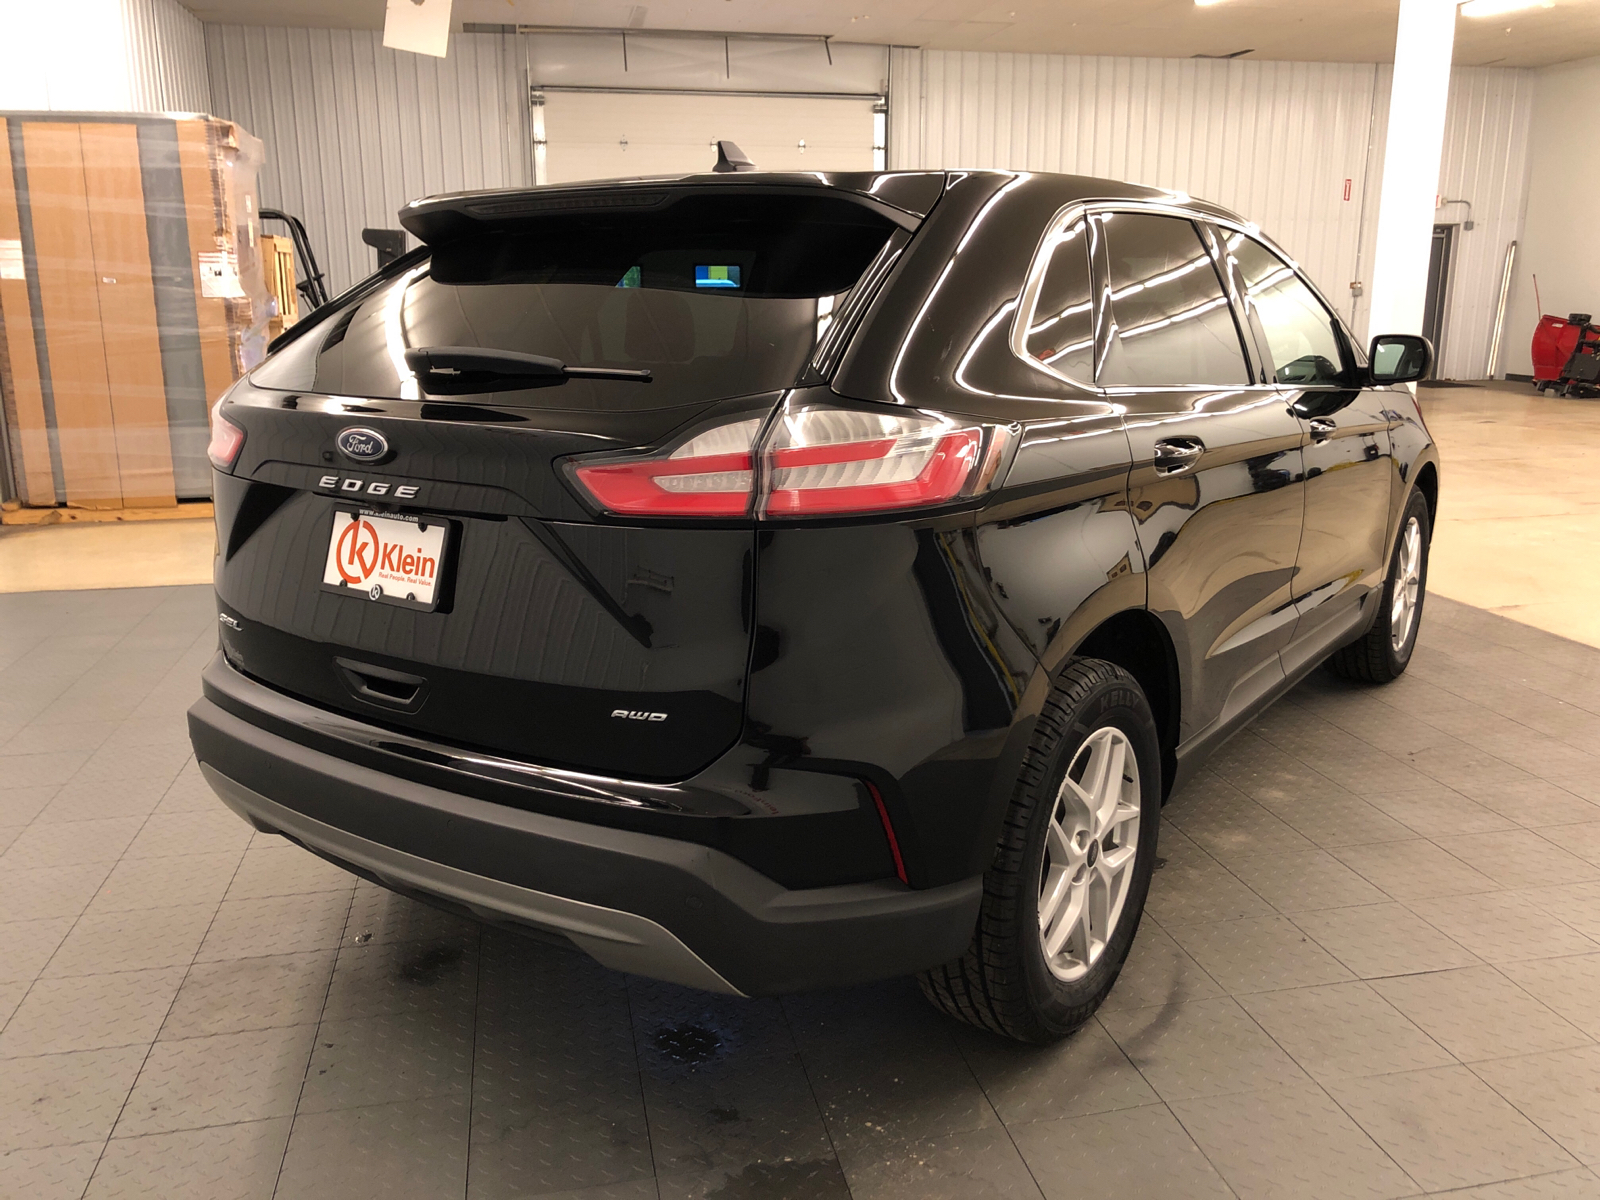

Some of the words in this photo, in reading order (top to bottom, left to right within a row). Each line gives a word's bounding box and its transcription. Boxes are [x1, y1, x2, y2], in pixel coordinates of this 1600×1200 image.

[346, 434, 374, 454] Ford
[318, 475, 421, 499] EDGE
[380, 542, 436, 579] Klein
[378, 571, 389, 579] Real
[407, 576, 418, 584] Real
[1100, 689, 1140, 714] KELLY
[610, 709, 669, 722] AWD
